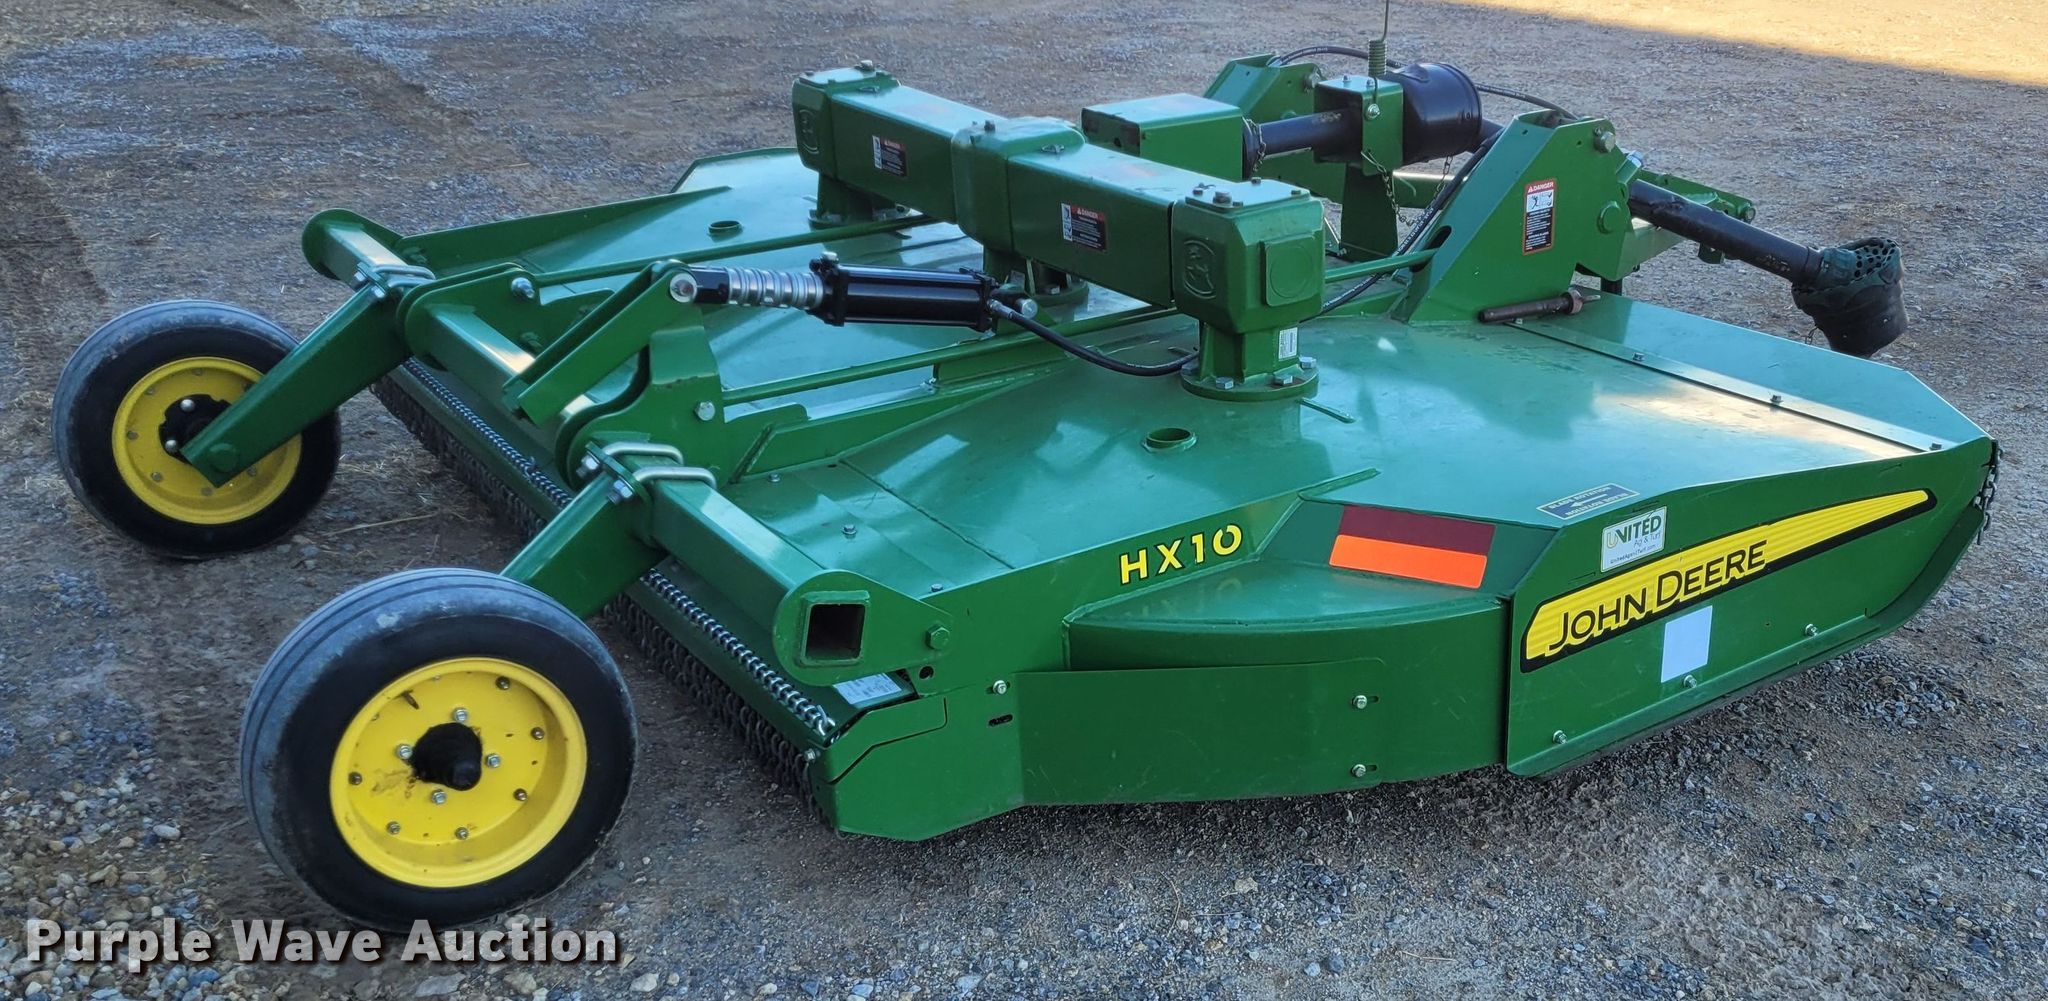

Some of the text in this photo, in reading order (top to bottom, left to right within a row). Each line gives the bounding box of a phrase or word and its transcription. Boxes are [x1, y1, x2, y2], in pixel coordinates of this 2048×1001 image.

[1120, 524, 1242, 585] HX10
[1607, 515, 1661, 549] UNITED
[1549, 540, 1767, 651] JOHN DEERE
